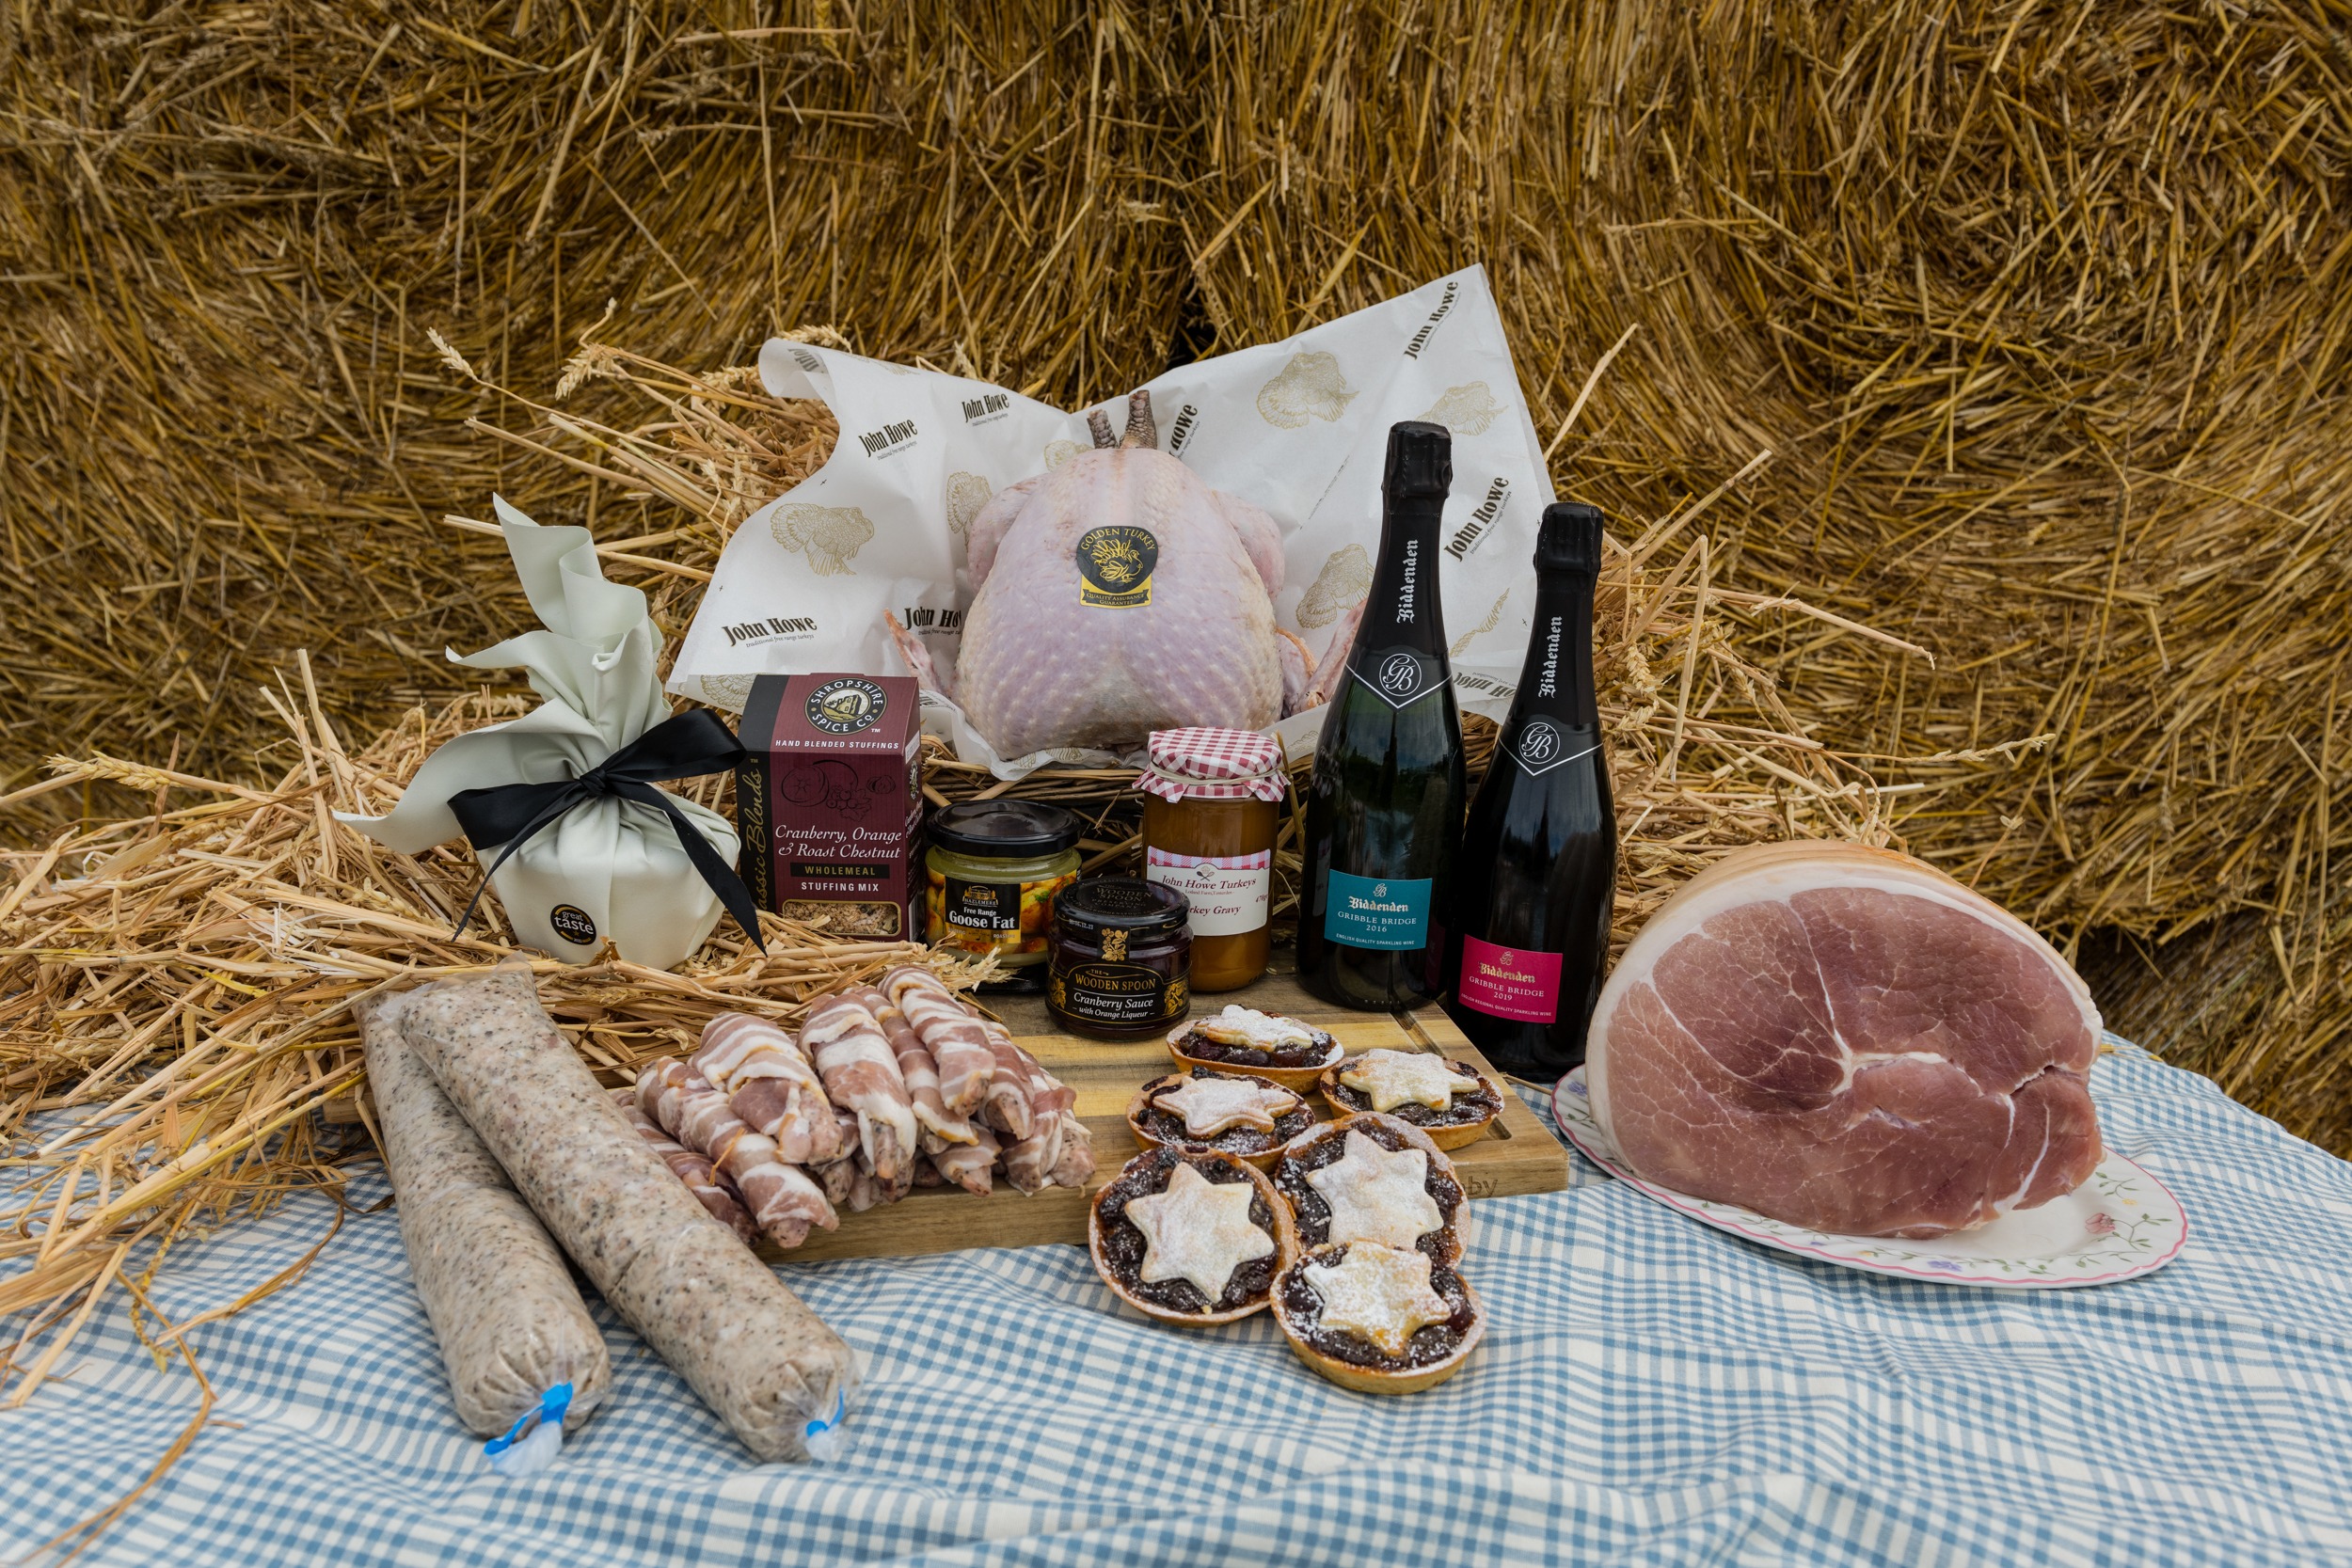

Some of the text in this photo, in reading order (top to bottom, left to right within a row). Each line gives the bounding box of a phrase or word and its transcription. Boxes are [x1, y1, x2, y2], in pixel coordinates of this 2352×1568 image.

[1429, 282, 1458, 322] Howe
[961, 400, 985, 423] John
[984, 394, 1009, 413] Howe
[858, 420, 917, 457] John Howe
[1444, 477, 1509, 562] John Howe
[1081, 529, 1155, 550] GOLDEN TURKEY
[1397, 540, 1418, 623] Biddenden
[904, 607, 934, 630] John
[722, 617, 817, 647] John Howe
[1538, 616, 1562, 698] Biddenden
[811, 680, 882, 705] SHROPSHIRE
[812, 713, 849, 732] SPICE
[742, 768, 768, 911] assic Blends
[775, 825, 901, 844] Cranberry, Orange
[797, 844, 835, 857] Roast
[840, 844, 901, 858] Chestnut
[805, 865, 876, 876] WHOLEMEAL
[802, 881, 879, 892] STUFFING MIX
[1163, 875, 1256, 889] John Howe Turkeys
[1096, 888, 1152, 898] WOODEN
[977, 909, 996, 917] Range
[1190, 906, 1241, 916] rkey Gravy
[1348, 896, 1408, 912] Biddenden
[563, 911, 583, 921] great
[949, 911, 1015, 928] Goose Fat
[1338, 911, 1377, 924] GRIBBLE
[554, 916, 594, 935] taste
[1479, 961, 1535, 983] Biddenden
[1075, 974, 1155, 990] WOODEN SPOON
[1470, 976, 1544, 997] GRIBBLE BRIDGE
[1074, 992, 1153, 1010] Cranberry Sauce
[1475, 998, 1494, 1008] REGIONAL
[1494, 992, 1513, 1001] 2019
[1079, 1006, 1148, 1020] with Orange Liqueur
